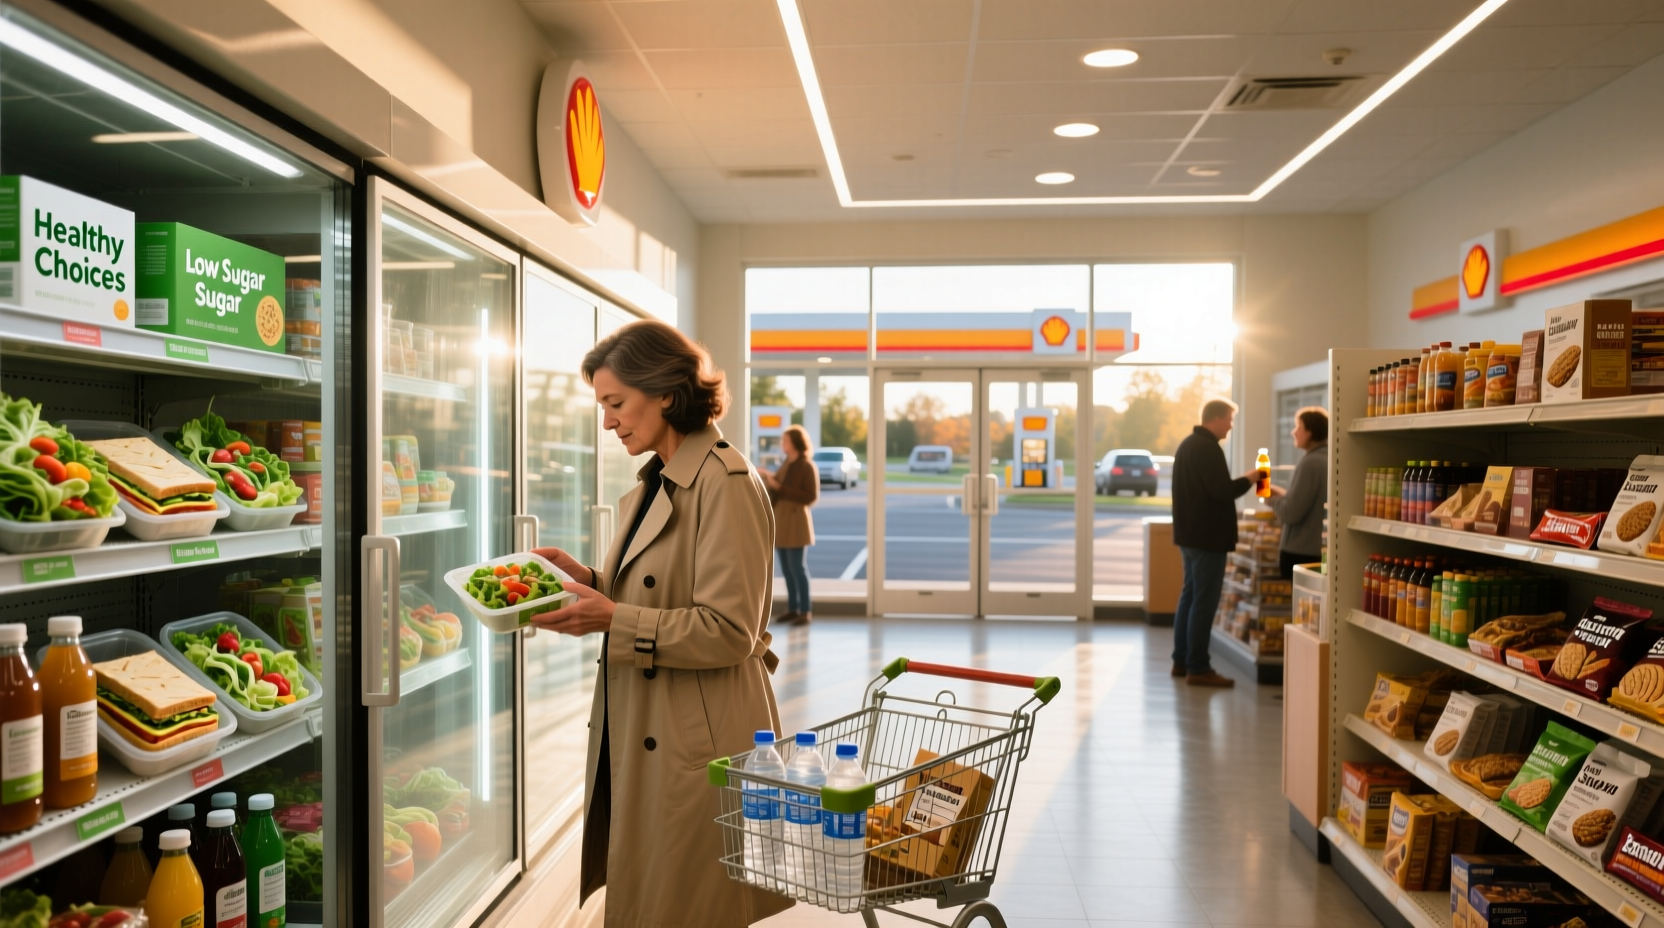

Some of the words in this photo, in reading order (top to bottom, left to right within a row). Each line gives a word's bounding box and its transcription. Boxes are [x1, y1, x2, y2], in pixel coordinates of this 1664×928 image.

[34, 207, 125, 265] Healthy
[34, 246, 126, 293] Choices
[185, 248, 220, 279] Low
[221, 258, 266, 295] Sugar
[195, 281, 242, 317] Sugar
